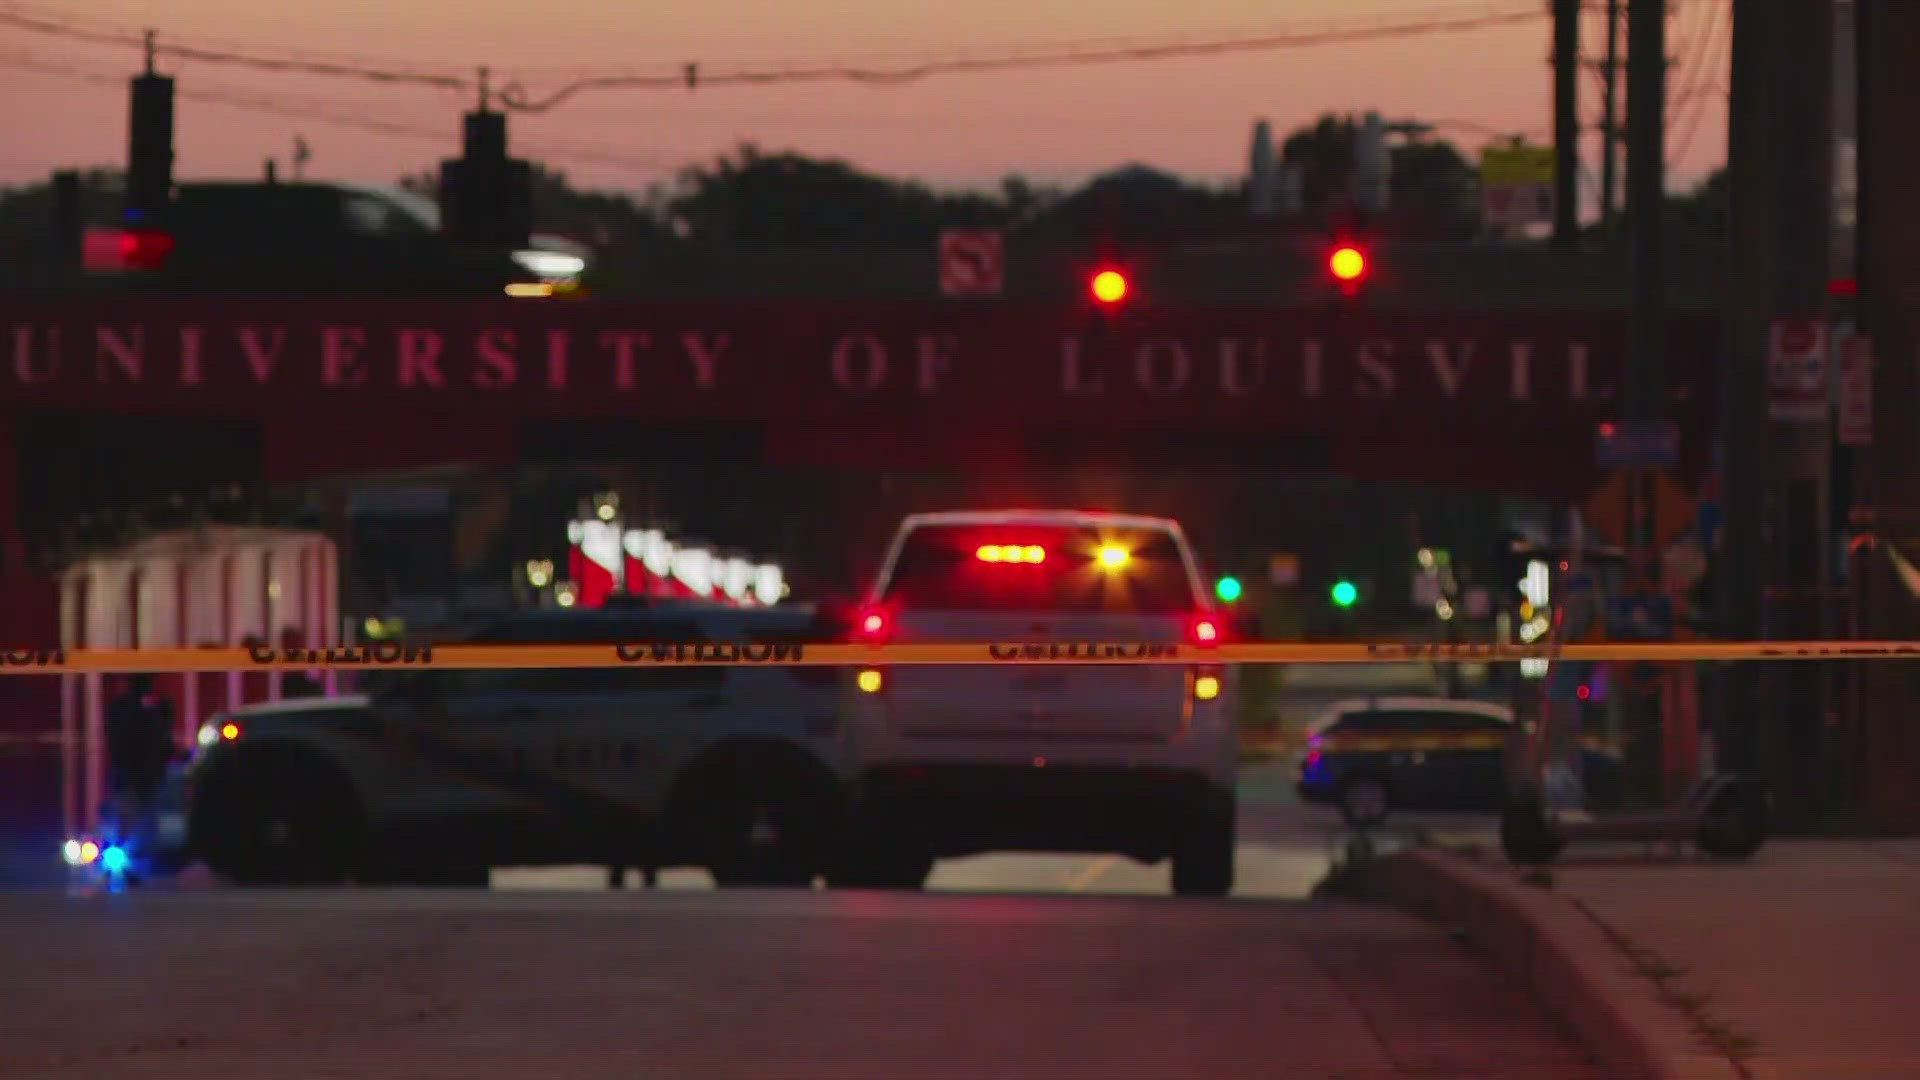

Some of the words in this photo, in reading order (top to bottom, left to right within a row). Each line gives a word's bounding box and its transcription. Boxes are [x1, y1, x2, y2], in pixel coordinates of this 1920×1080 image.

[11, 322, 733, 391] UNIVERSITY
[830, 333, 958, 391] OF
[1059, 336, 1692, 400] LOUISVIL
